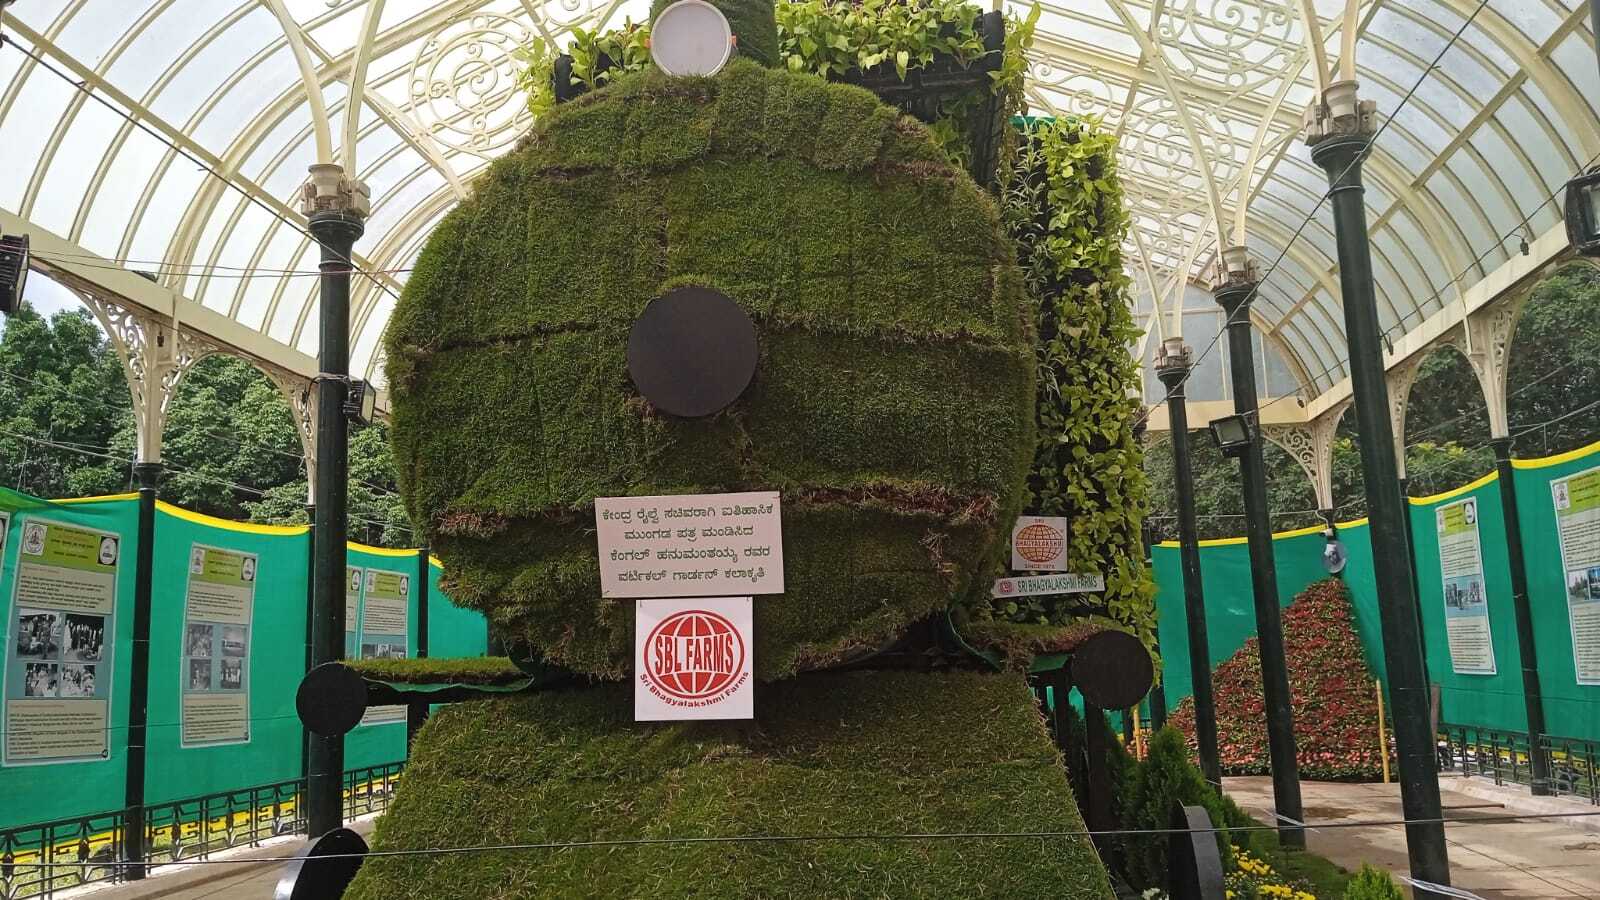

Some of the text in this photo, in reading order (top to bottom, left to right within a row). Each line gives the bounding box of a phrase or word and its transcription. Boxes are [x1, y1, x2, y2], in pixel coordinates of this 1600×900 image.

[602, 508, 632, 523] ಕೇಂದ್ರ
[664, 506, 716, 519] ಸಚಿವರಾಗಿ
[722, 503, 774, 517] ಐತಿಹಾಸಿಕ
[624, 525, 754, 542] ಮುಂಗಡ ಪತ್ರ ಮಂಡಿಸಿದ
[610, 546, 770, 563] ಕೆಂಗಲ್ ಹನುಮಂತಯ್ಯ ರವರ
[672, 568, 718, 581] ಗಾರ್ಡನ್
[724, 567, 765, 583] ಕಲಾಕೃತಿ
[1018, 575, 1097, 592] SRI BHAGYALAKSHMI FARMS
[655, 633, 734, 675] SBL FARMS
[640, 671, 749, 708] Sri Bhagyalakshmi Farms
